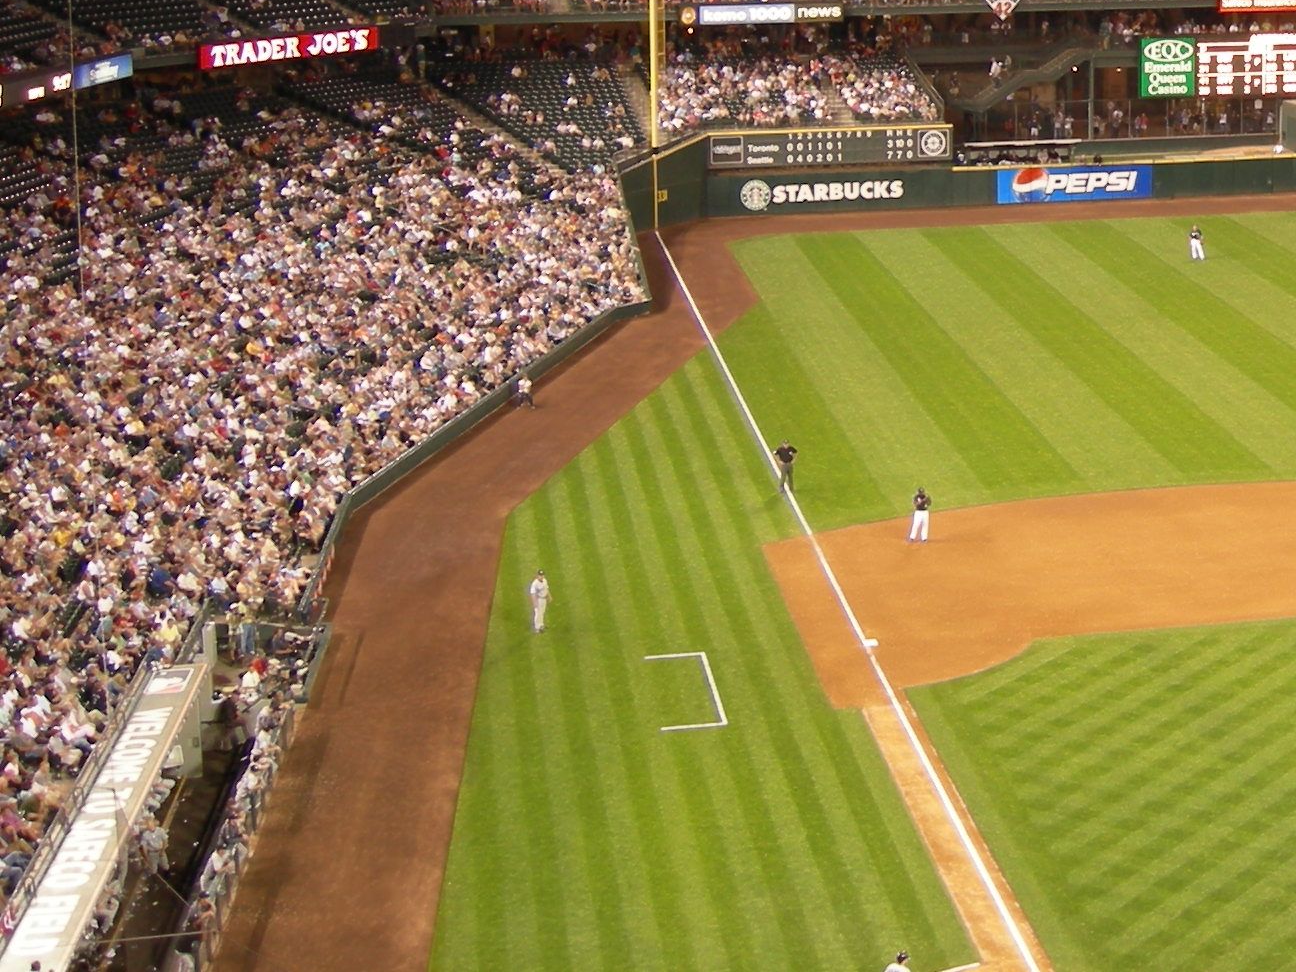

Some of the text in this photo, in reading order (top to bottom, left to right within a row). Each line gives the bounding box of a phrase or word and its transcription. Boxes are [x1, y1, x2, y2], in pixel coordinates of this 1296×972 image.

[749, 7, 791, 21] 1000
[797, 6, 841, 18] news
[211, 29, 370, 67] TRADER JOE'S
[1144, 60, 1193, 73] Emerald
[1149, 73, 1187, 86] Queen
[1147, 83, 1188, 95] Casino
[747, 144, 780, 153] Toronto
[746, 156, 775, 165] Seattle
[1045, 171, 1138, 195] PEPSI
[772, 180, 904, 204] STARBUCKS
[96, 706, 174, 784] WELCOME
[38, 818, 119, 888] SAFECO
